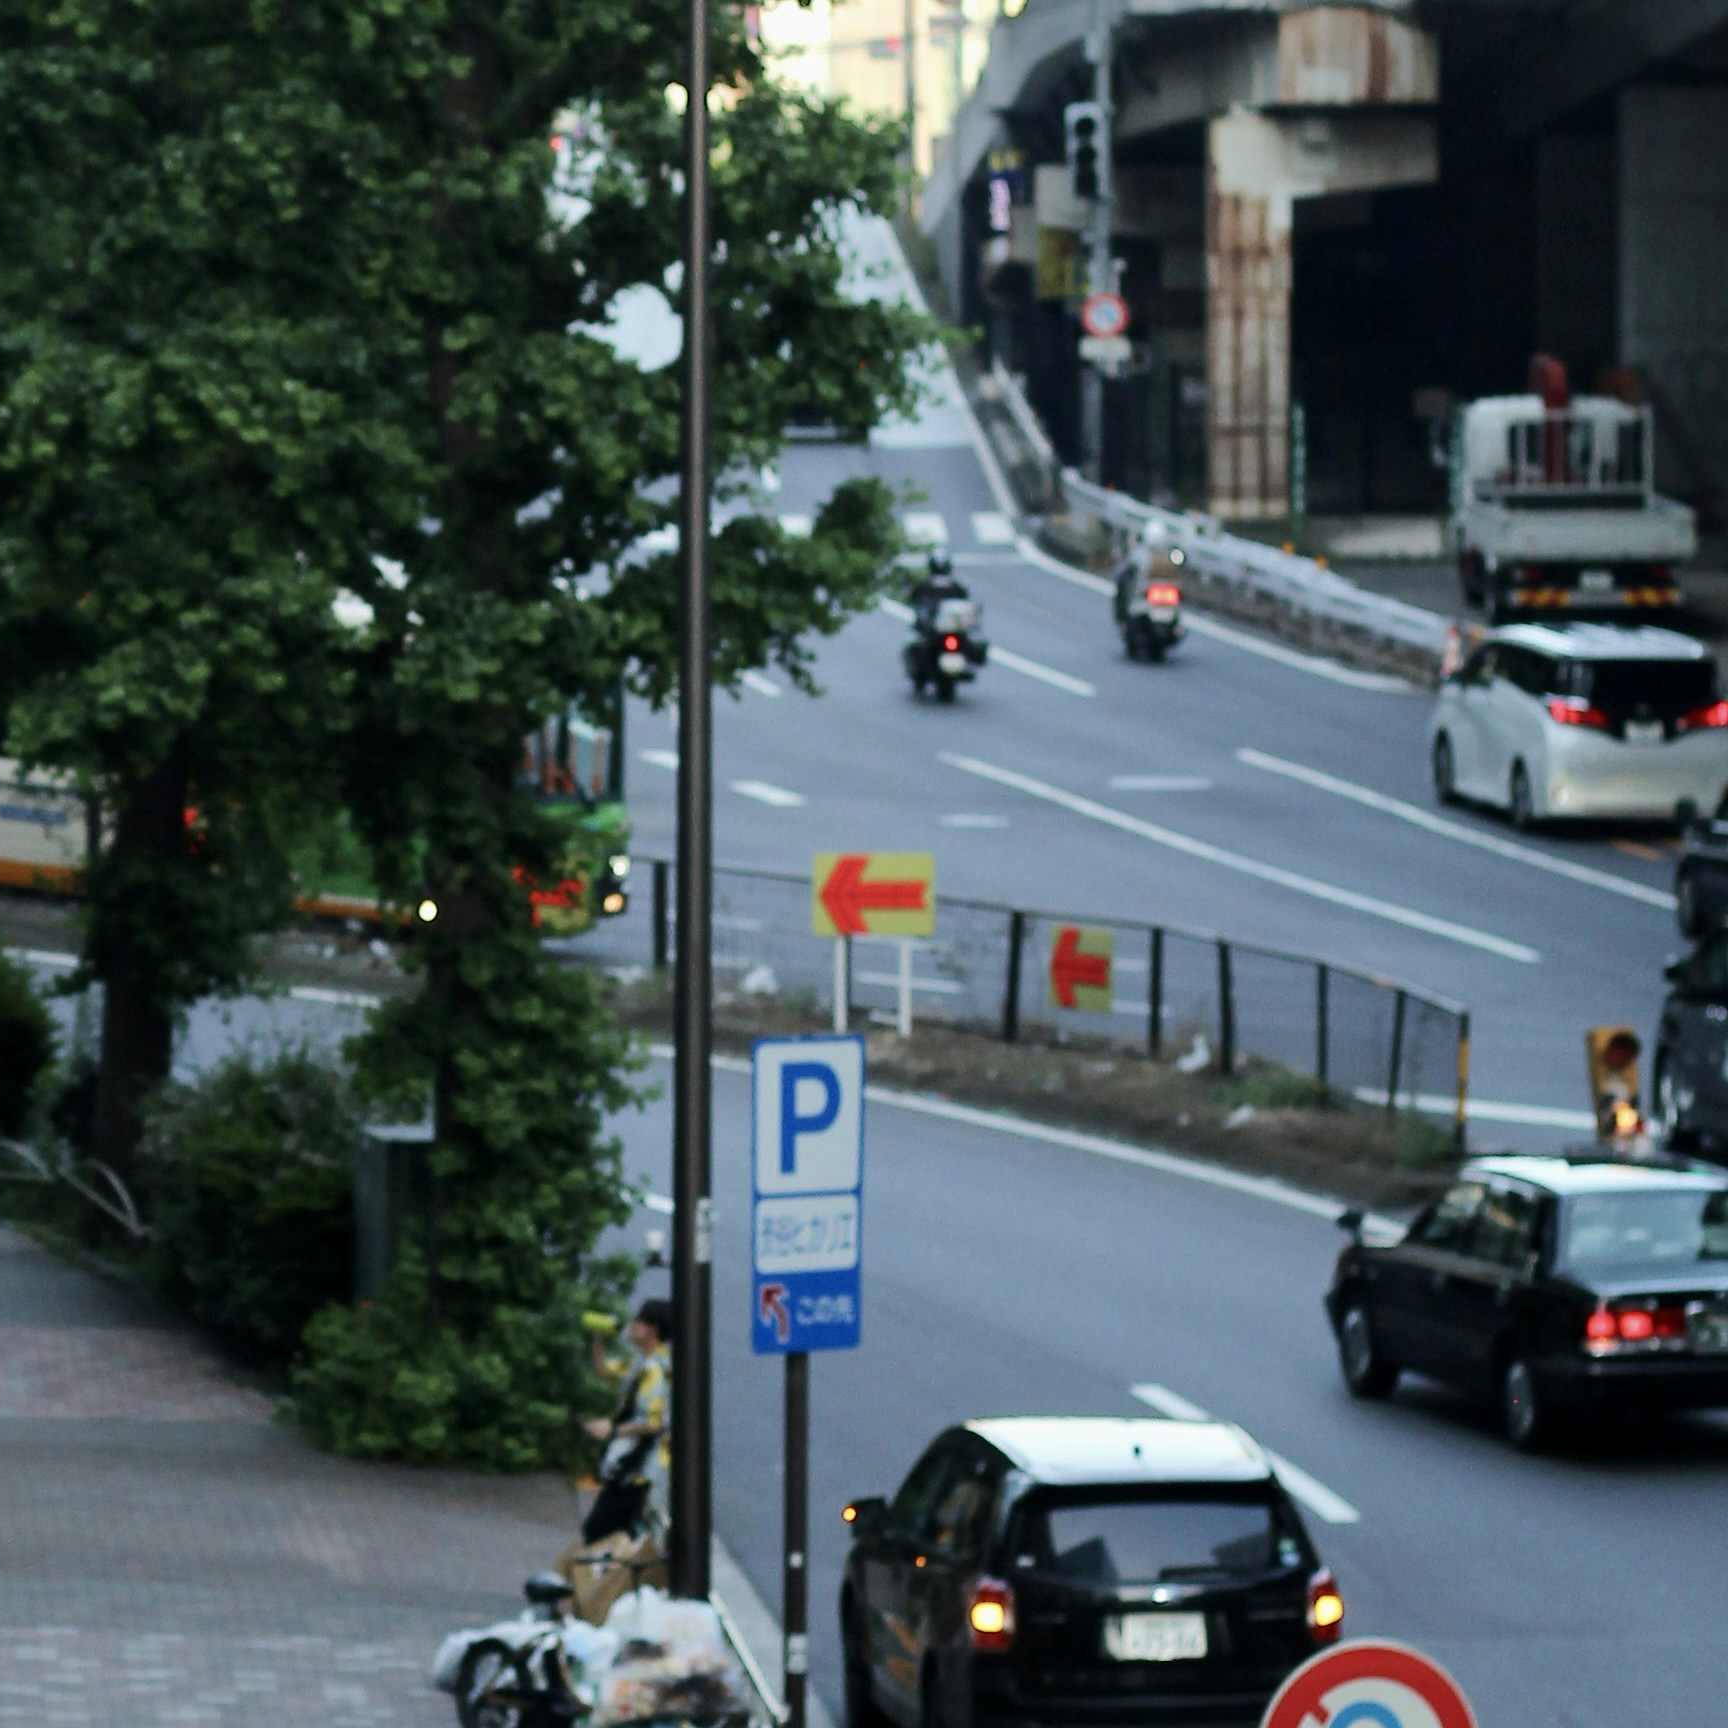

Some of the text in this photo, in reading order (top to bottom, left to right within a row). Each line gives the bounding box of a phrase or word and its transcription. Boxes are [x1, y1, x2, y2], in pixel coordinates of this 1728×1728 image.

[780, 1062, 841, 1174] P
[796, 1294, 855, 1326] この先
